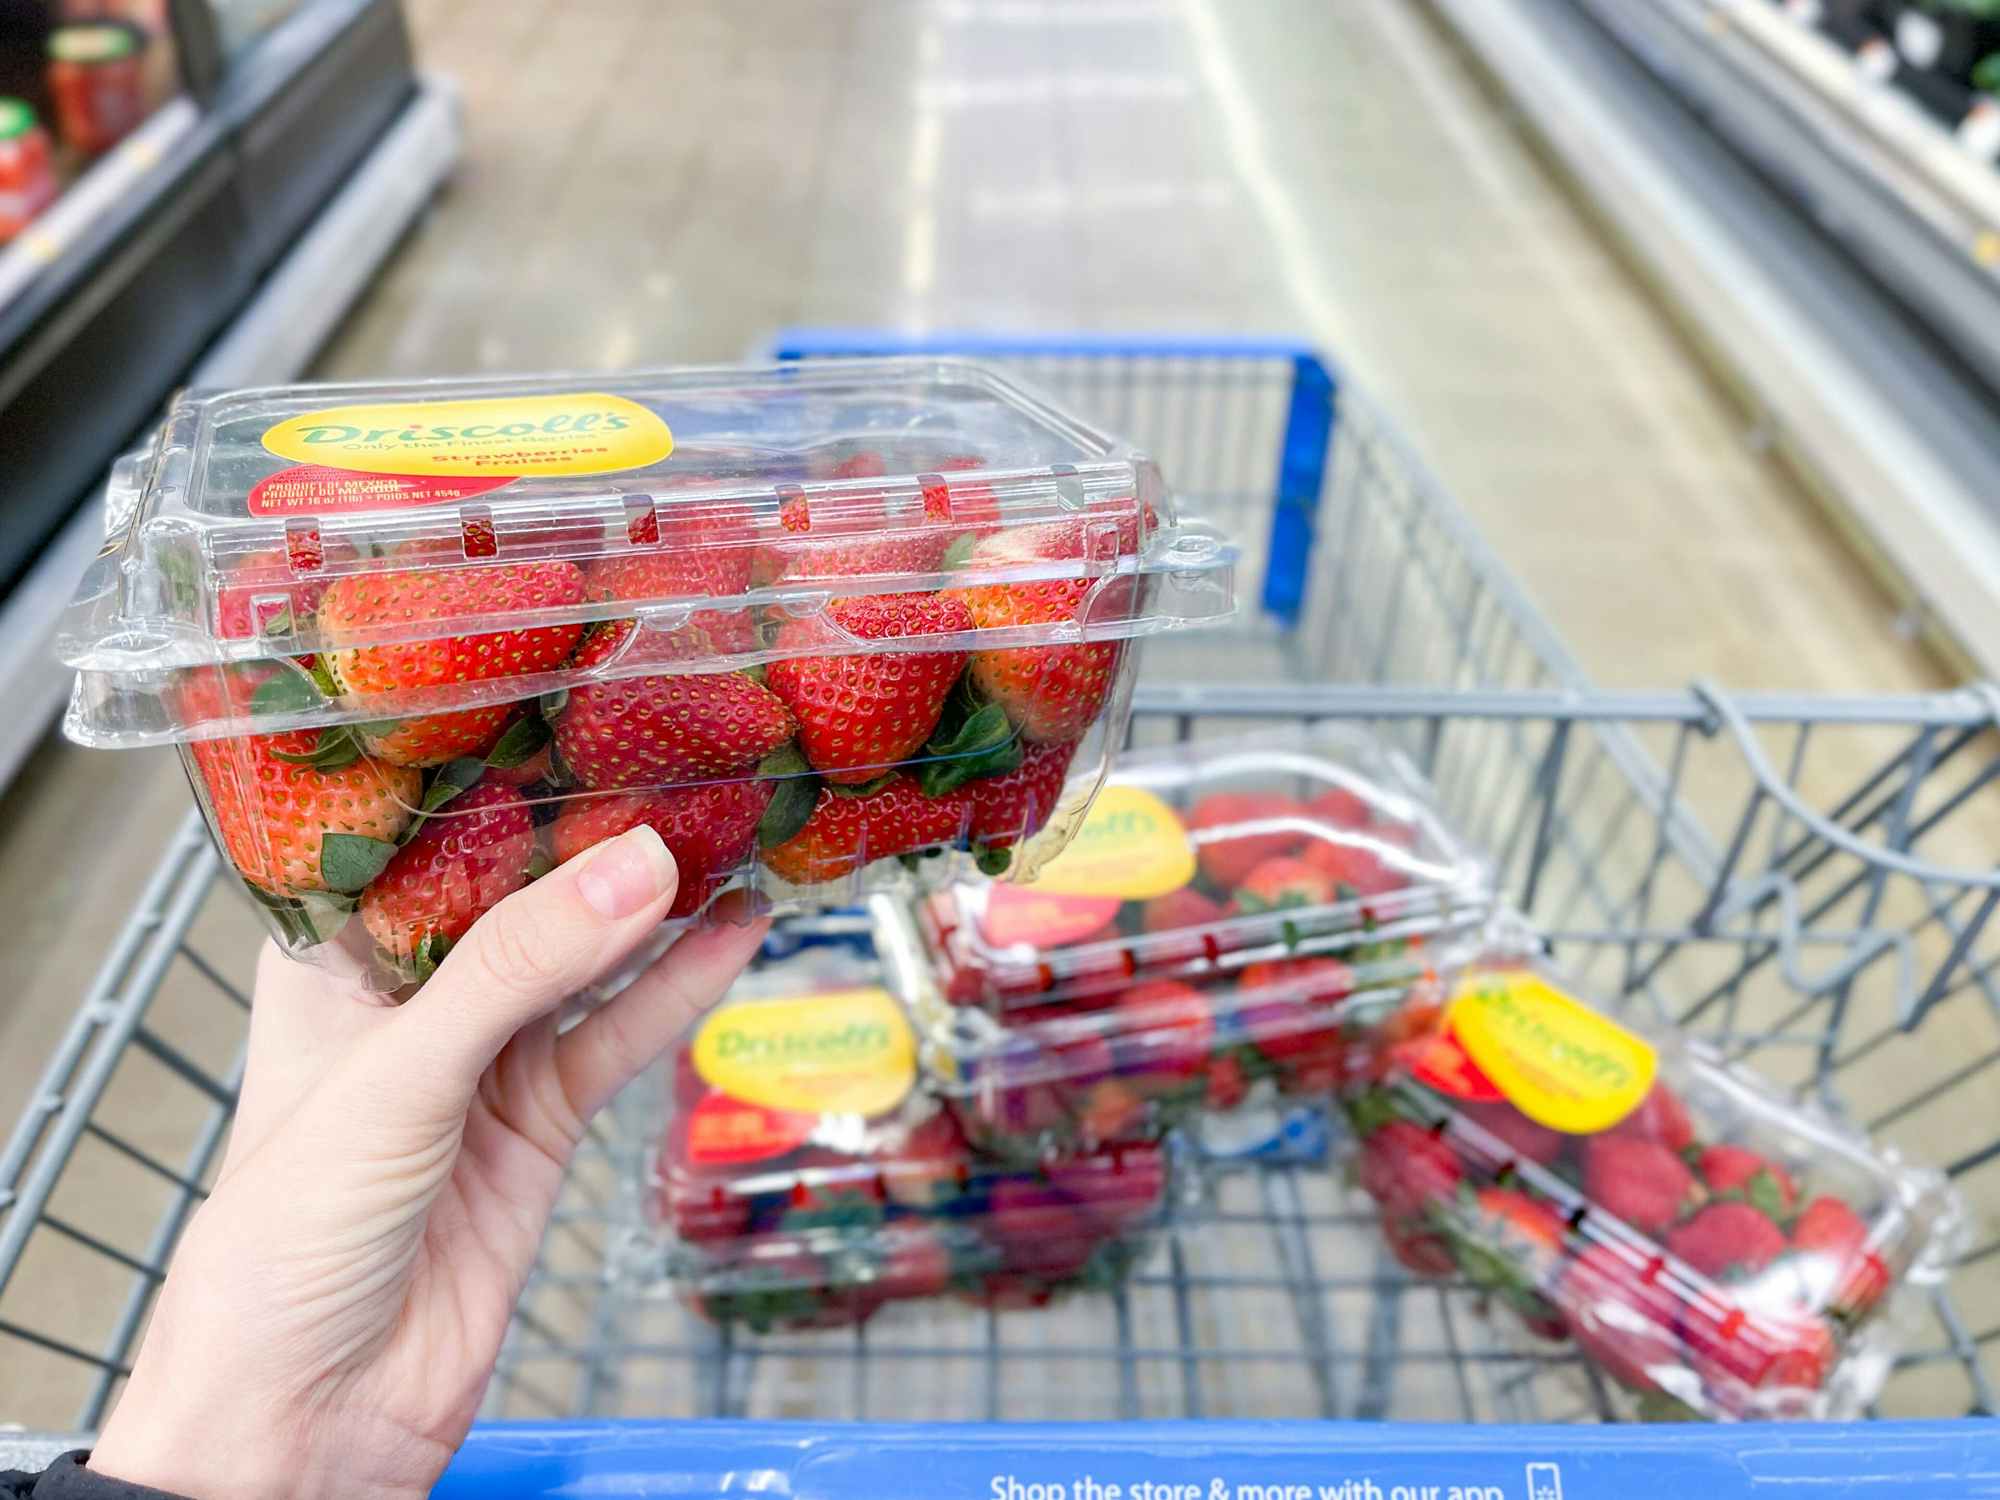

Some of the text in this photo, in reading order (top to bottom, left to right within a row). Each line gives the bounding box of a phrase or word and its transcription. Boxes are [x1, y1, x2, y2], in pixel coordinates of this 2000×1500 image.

[296, 411, 630, 444] Driscoll's
[343, 433, 598, 450] Only the Finest Berries
[431, 447, 609, 462] Strawberries
[475, 456, 573, 467] Fraises
[262, 485, 316, 499] PRODUIT
[267, 480, 320, 492] PRODUCT
[261, 498, 282, 508] NET
[287, 497, 305, 507] WT
[308, 496, 321, 506] 16
[377, 491, 409, 501] POIDS
[411, 490, 431, 499] NET
[990, 1475, 1066, 1500] Shop
[1072, 1475, 1122, 1500] the
[1129, 1479, 1202, 1500] store
[1207, 1476, 1230, 1500] &
[1236, 1483, 1312, 1500] more
[1317, 1477, 1383, 1500] with
[1390, 1484, 1440, 1500] our
